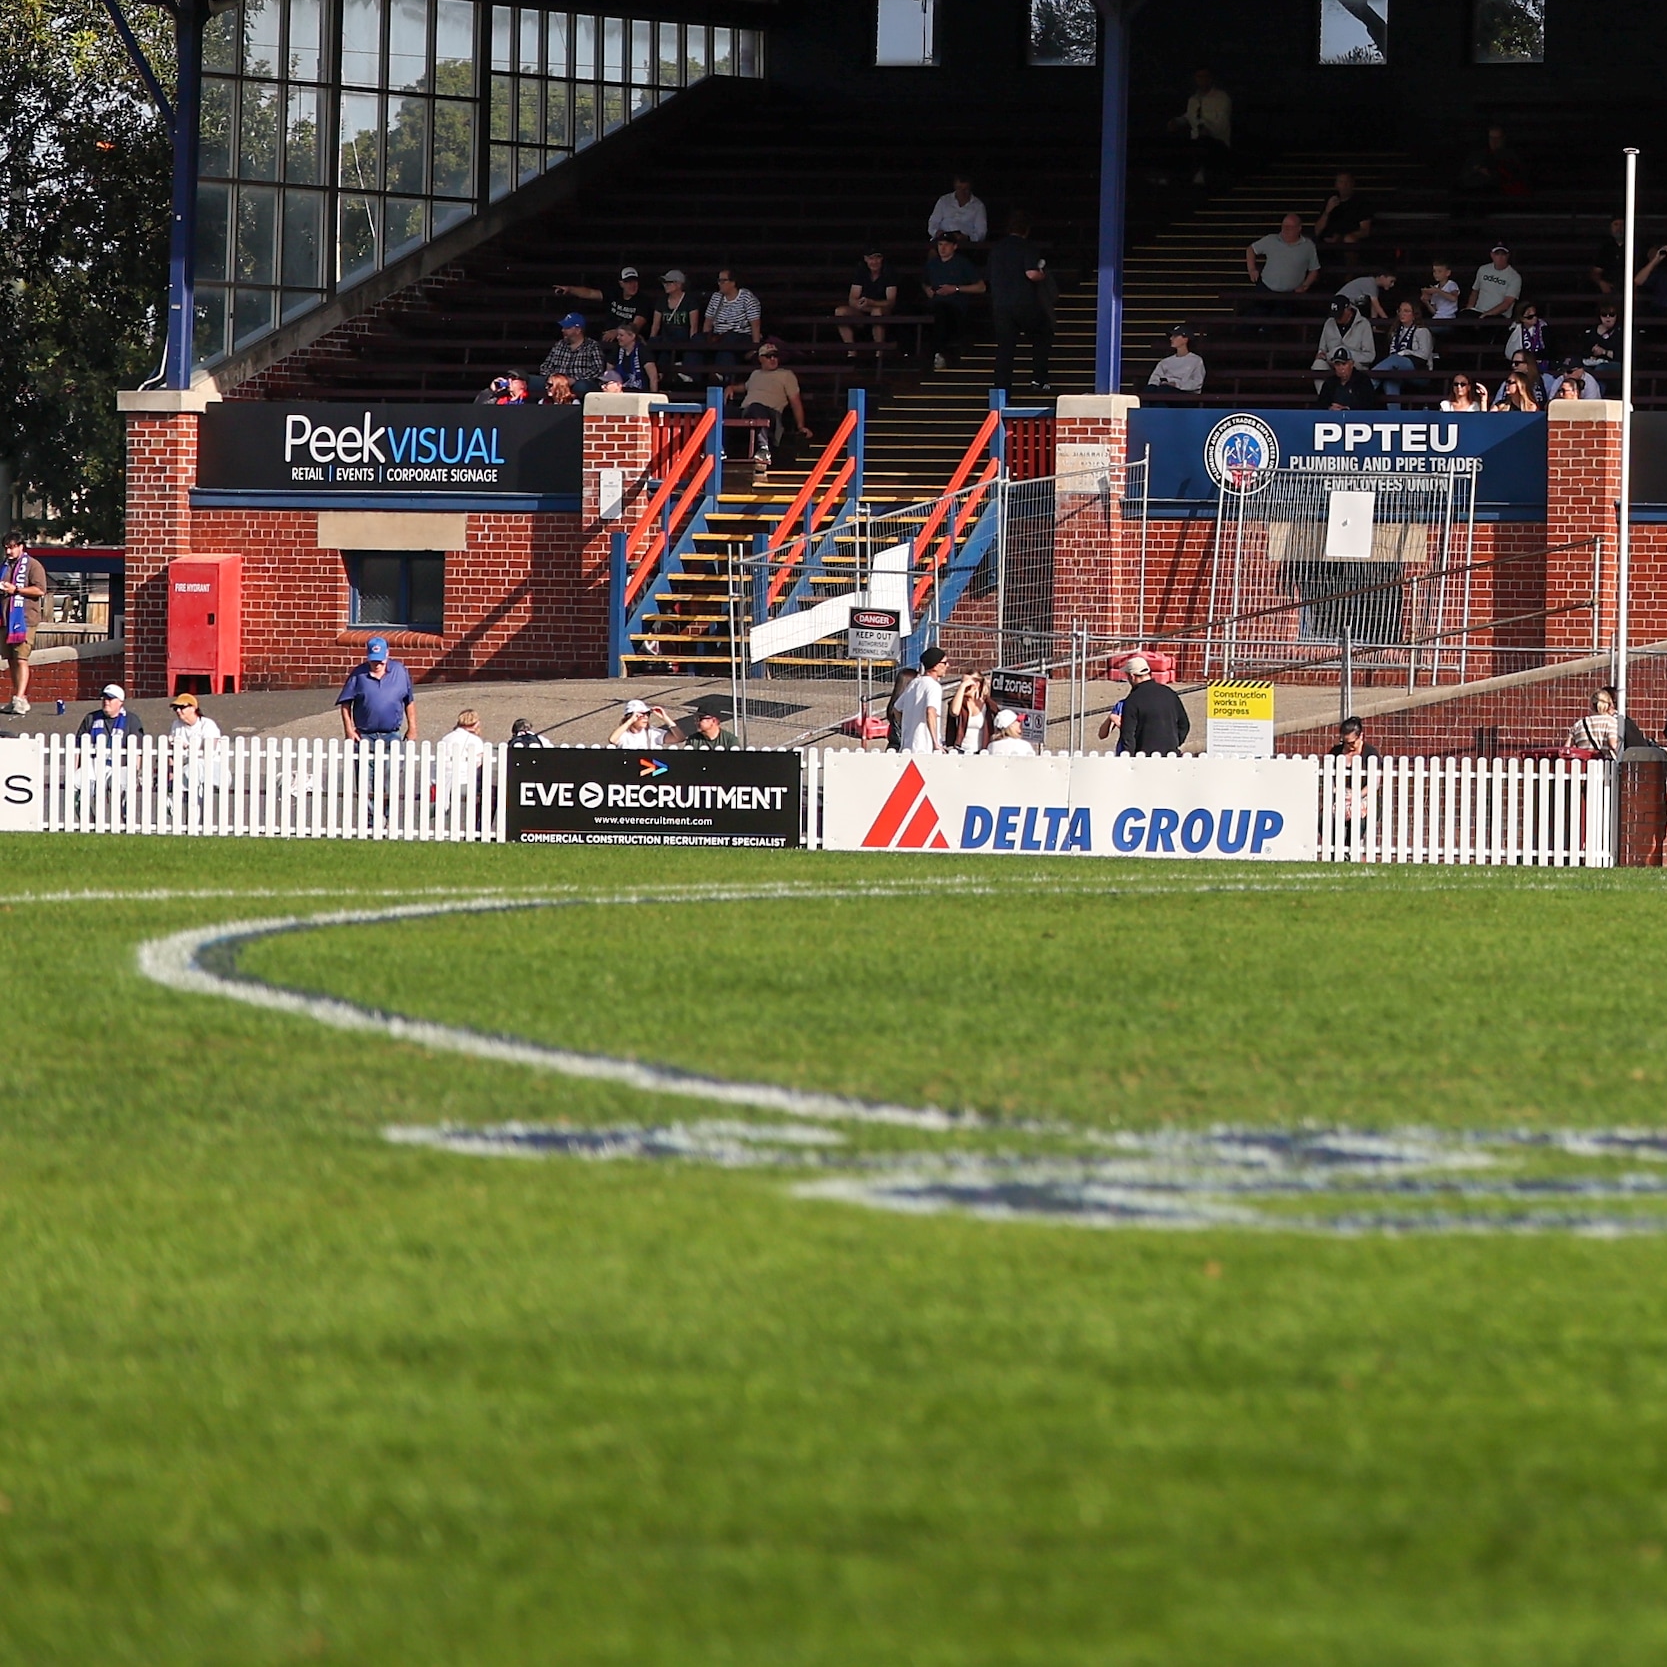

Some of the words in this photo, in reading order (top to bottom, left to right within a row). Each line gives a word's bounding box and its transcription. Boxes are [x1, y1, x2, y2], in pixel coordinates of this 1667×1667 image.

[1483, 275, 1506, 286] adidas
[1231, 417, 1256, 428] TRADES
[1314, 423, 1458, 452] PPTEU
[1290, 456, 1358, 472] PLUMBING
[1362, 457, 1391, 472] AND
[1396, 457, 1426, 472] PIPE
[1429, 457, 1483, 473] TRADES
[291, 467, 324, 481] RETAIL
[336, 467, 374, 482] EVENTS
[386, 468, 448, 482] CORPORATE
[450, 468, 498, 483] SIGNAGE
[1404, 479, 1448, 493] UNION
[174, 583, 187, 592] FIRE
[859, 615, 890, 624] DANGER
[855, 631, 874, 639] KEEP
[876, 632, 892, 640] OUT
[1004, 679, 1033, 694] zones
[1213, 690, 1266, 699] Construction
[1213, 708, 1249, 716] progress
[519, 782, 574, 806] EVE
[607, 784, 787, 810] RECRUITMENT
[594, 815, 713, 826] www.everecruitment.com
[960, 805, 1092, 851] DELTA
[1111, 807, 1284, 854] GROUP
[520, 833, 584, 844] COMMERCIAL
[586, 834, 661, 845] CONSTRUCTION
[663, 835, 730, 846] RECRUITMENT
[732, 836, 786, 847] SPECIALIST
